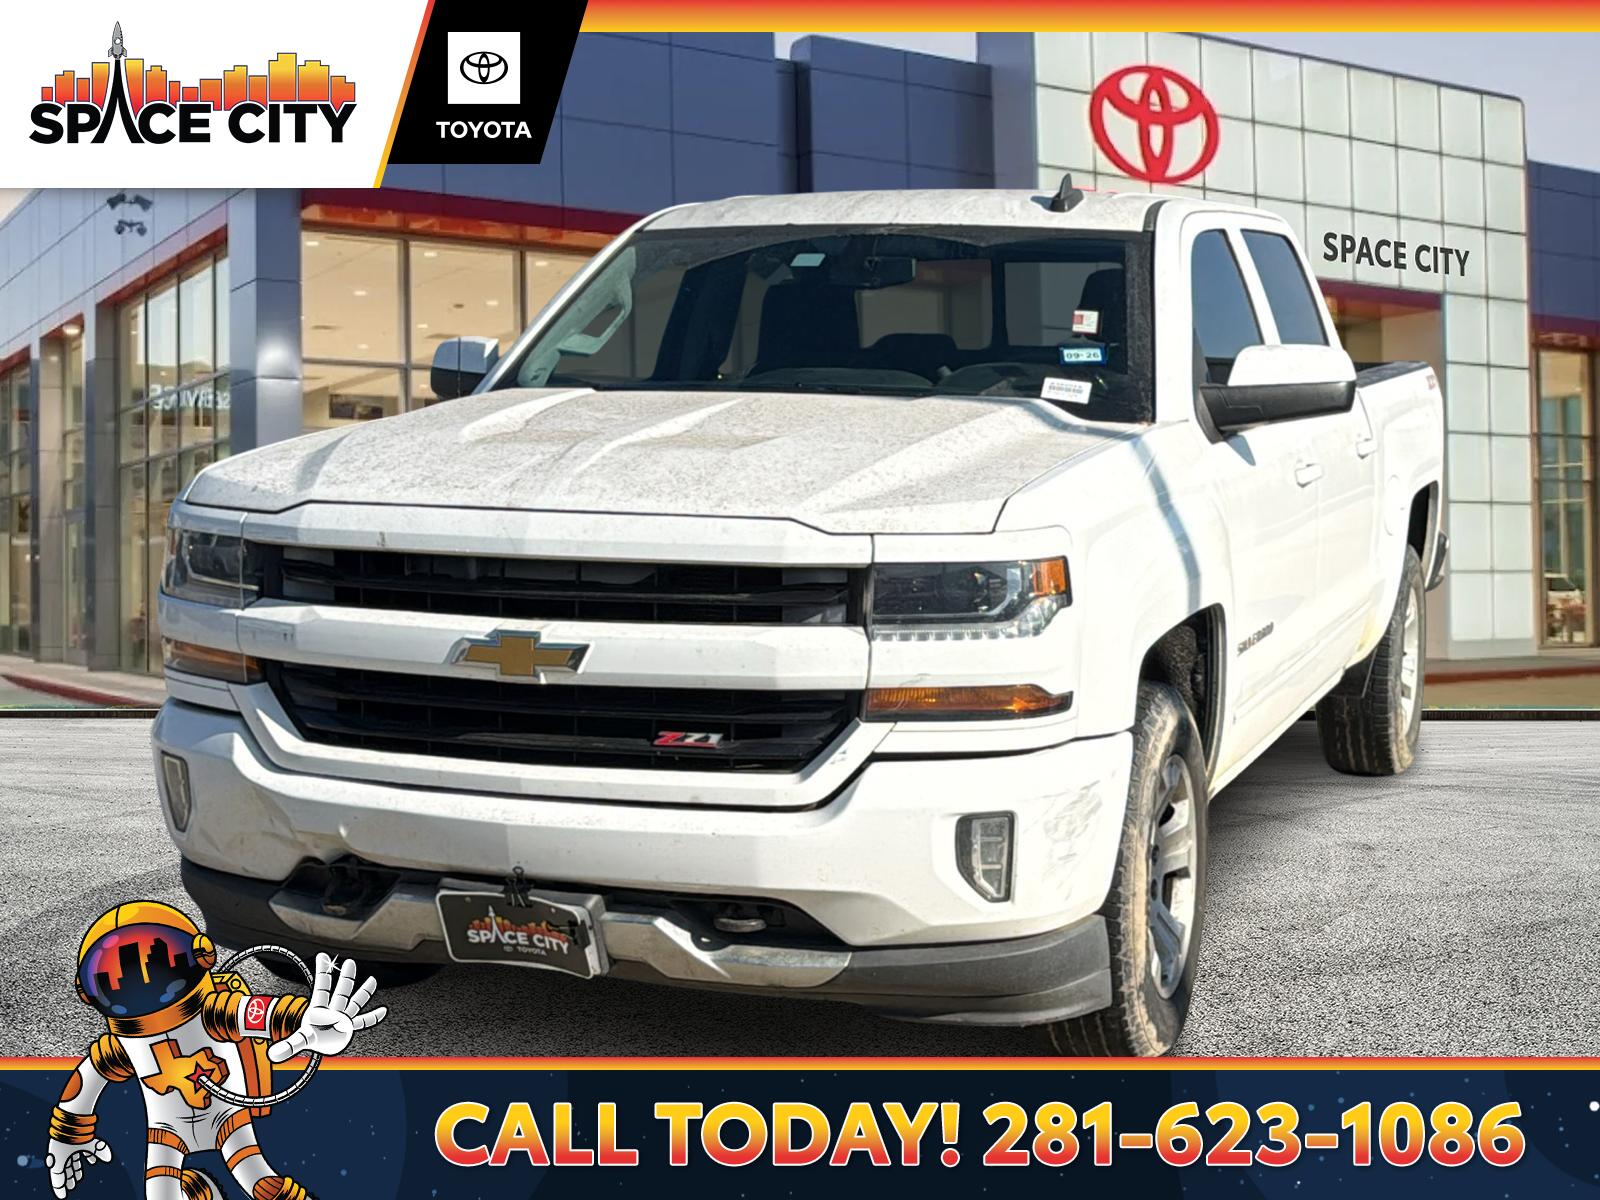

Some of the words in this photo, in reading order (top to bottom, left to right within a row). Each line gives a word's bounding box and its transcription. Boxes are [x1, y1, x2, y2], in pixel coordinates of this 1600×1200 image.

[1322, 231, 1408, 271] SPACE
[1414, 243, 1471, 278] CITY
[653, 731, 724, 749] Z71
[466, 928, 530, 945] SPACE
[532, 933, 569, 955] CITY
[516, 945, 548, 956] TOYOTA
